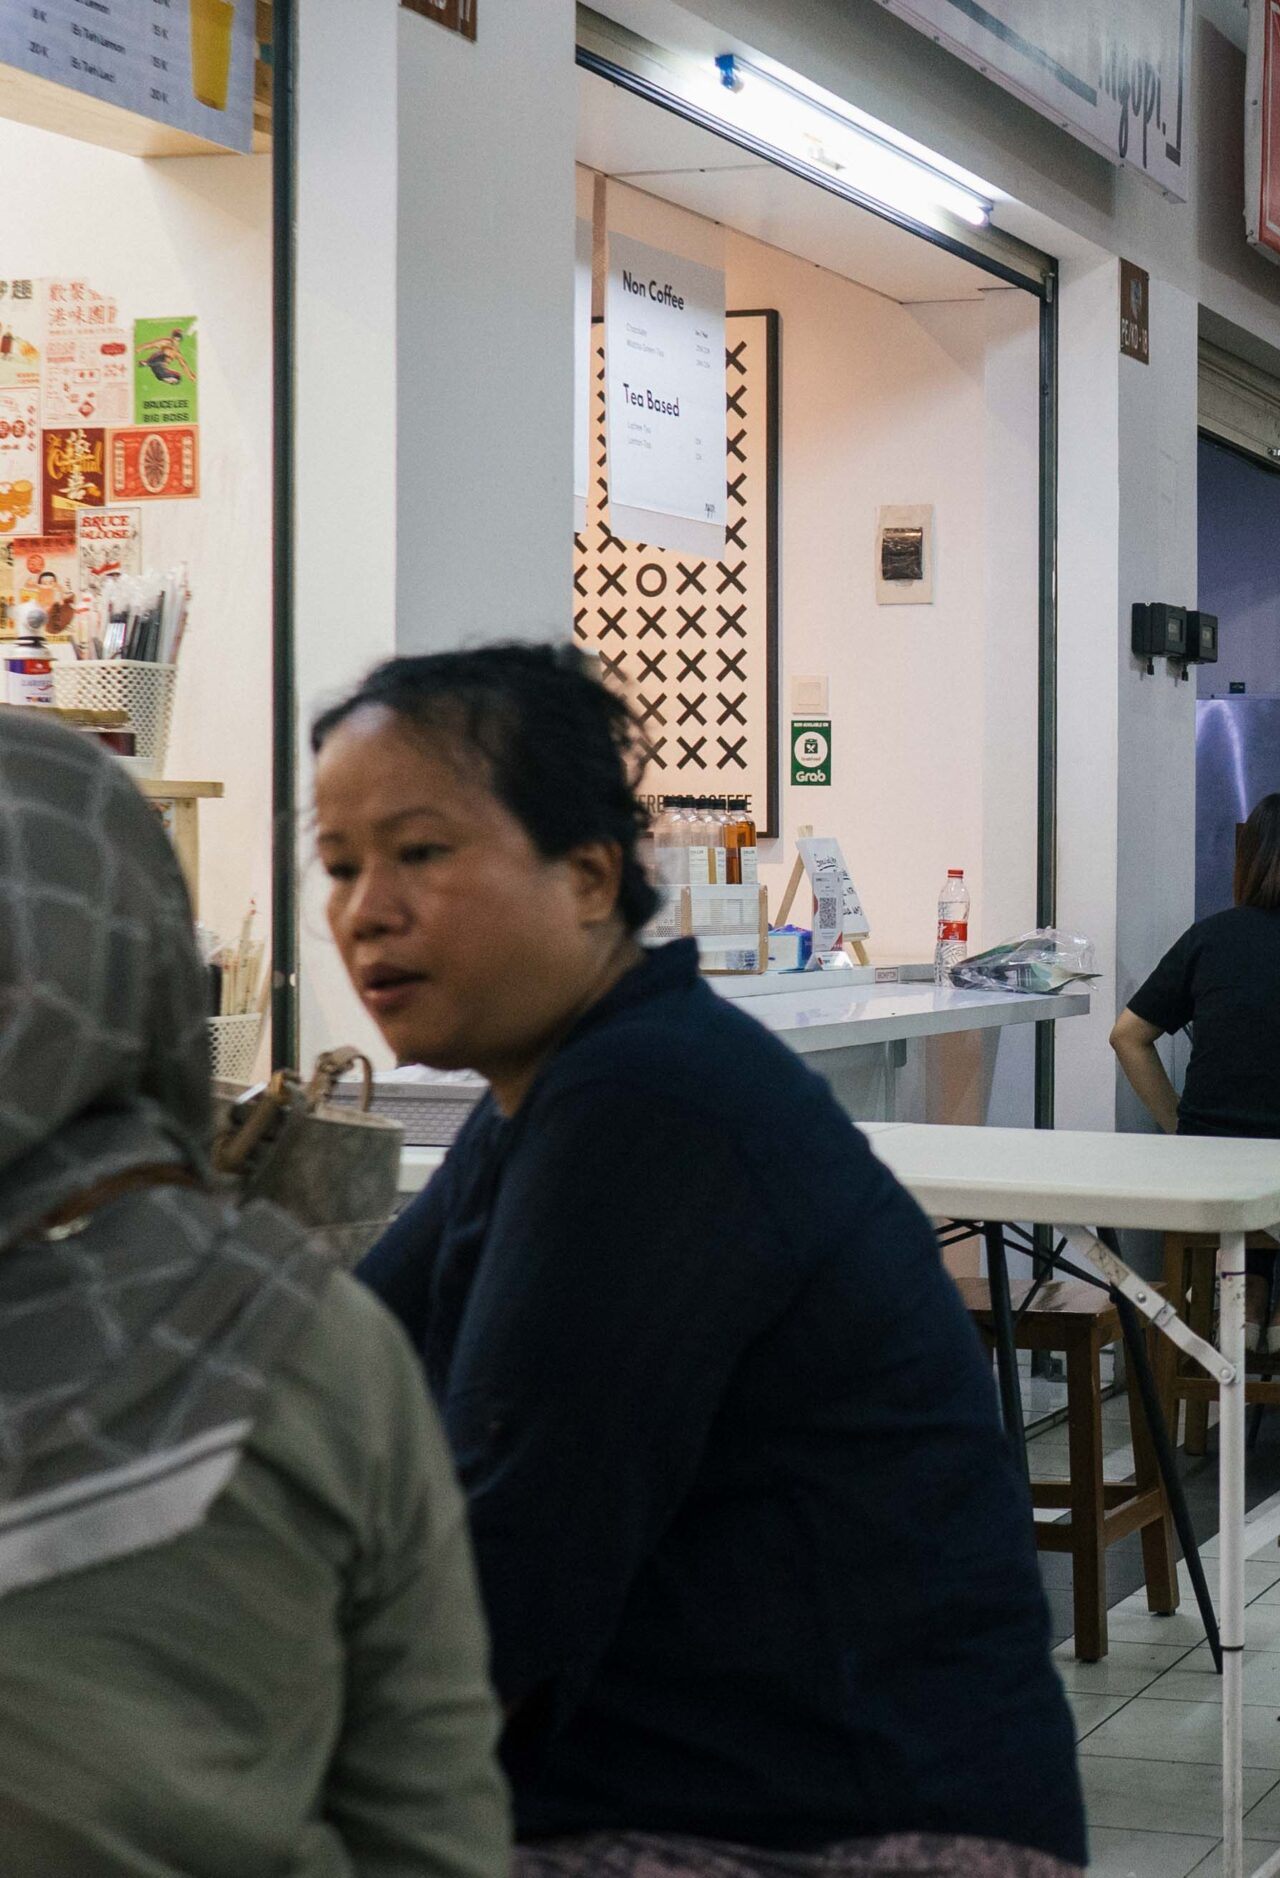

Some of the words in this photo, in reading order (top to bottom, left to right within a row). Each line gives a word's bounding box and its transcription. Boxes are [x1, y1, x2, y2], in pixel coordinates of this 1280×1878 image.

[623, 269, 646, 297] Non
[648, 280, 685, 311] Coffee
[143, 400, 173, 409] BRUCE
[173, 399, 189, 408] LEE
[623, 383, 644, 407] Tea
[646, 389, 680, 417] Based
[143, 413, 160, 422] BIG
[162, 412, 190, 422] BOSS
[80, 515, 129, 528] BRUCE
[796, 769, 826, 782] Grab
